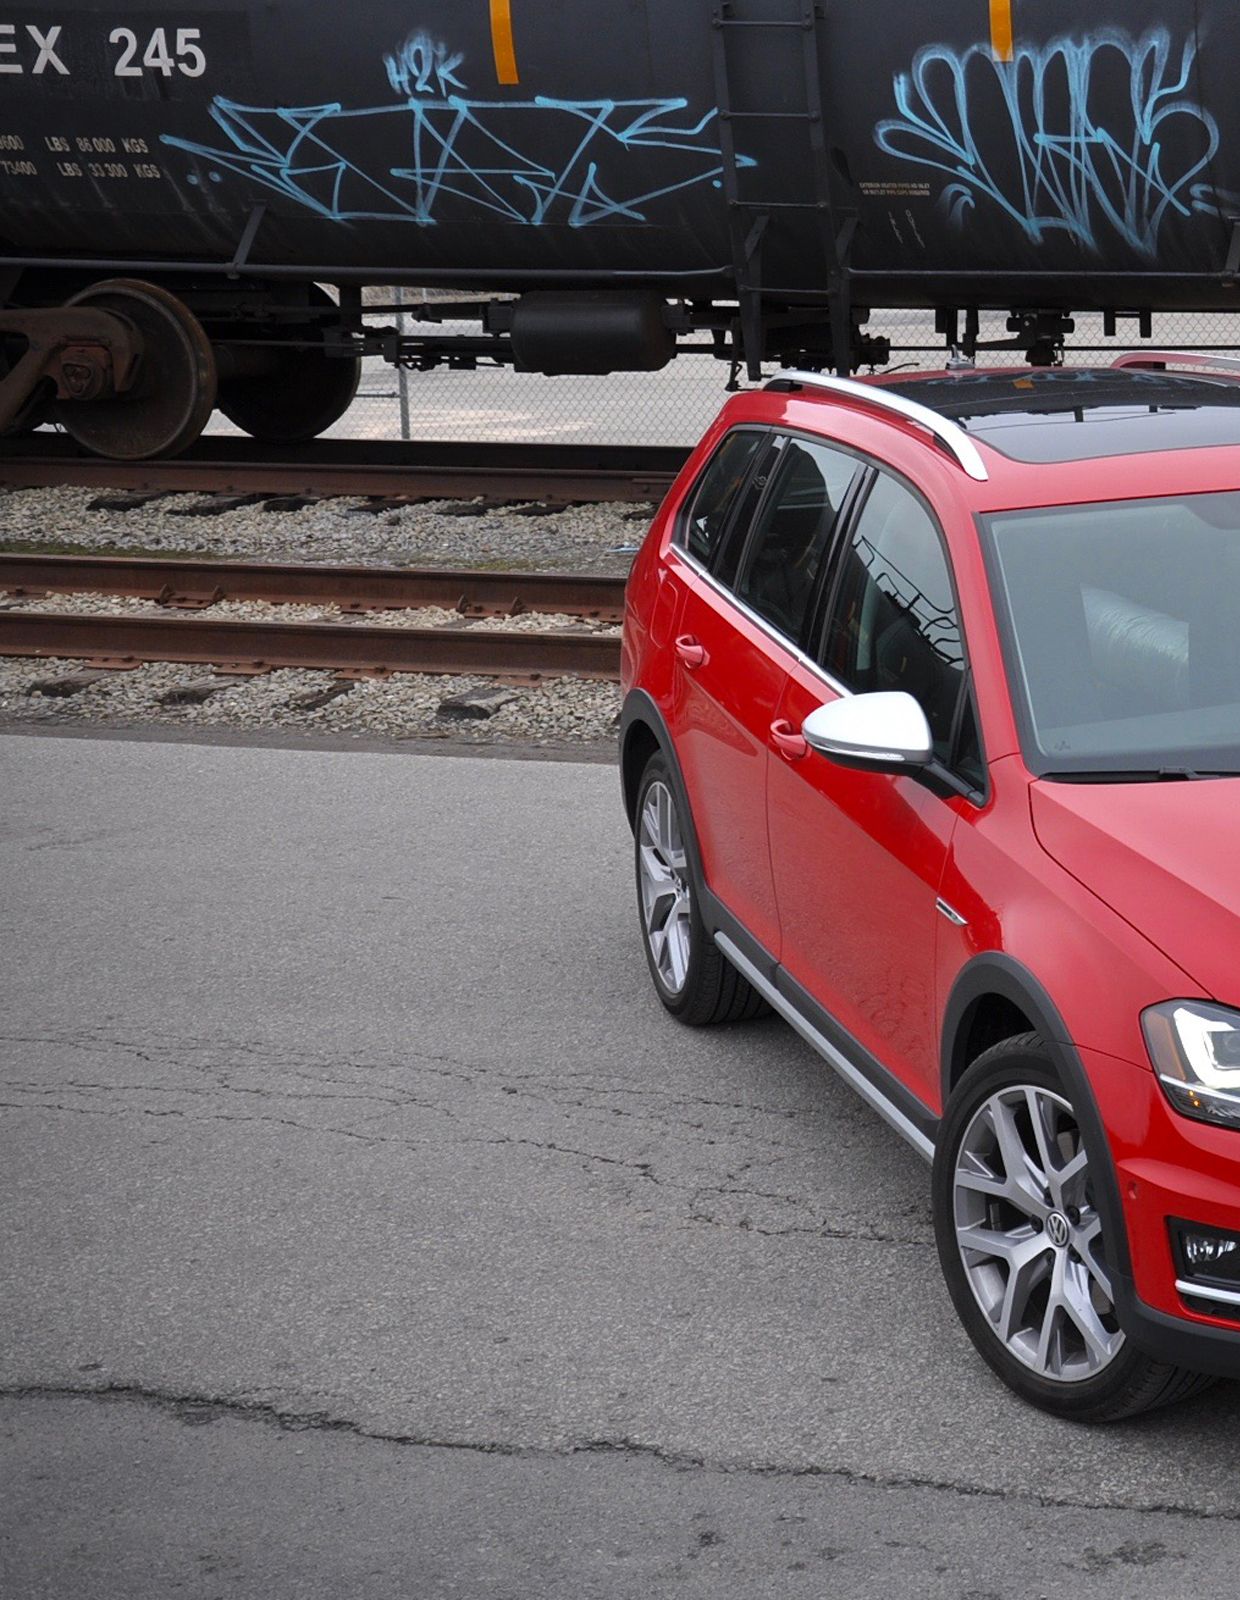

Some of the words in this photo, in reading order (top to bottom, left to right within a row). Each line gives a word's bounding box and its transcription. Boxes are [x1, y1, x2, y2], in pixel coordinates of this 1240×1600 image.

[0, 25, 71, 75] EX
[109, 27, 206, 77] 245
[44, 136, 71, 152] LBS
[121, 138, 149, 153] KGS
[56, 162, 83, 177] LBS
[133, 164, 161, 178] KGS
